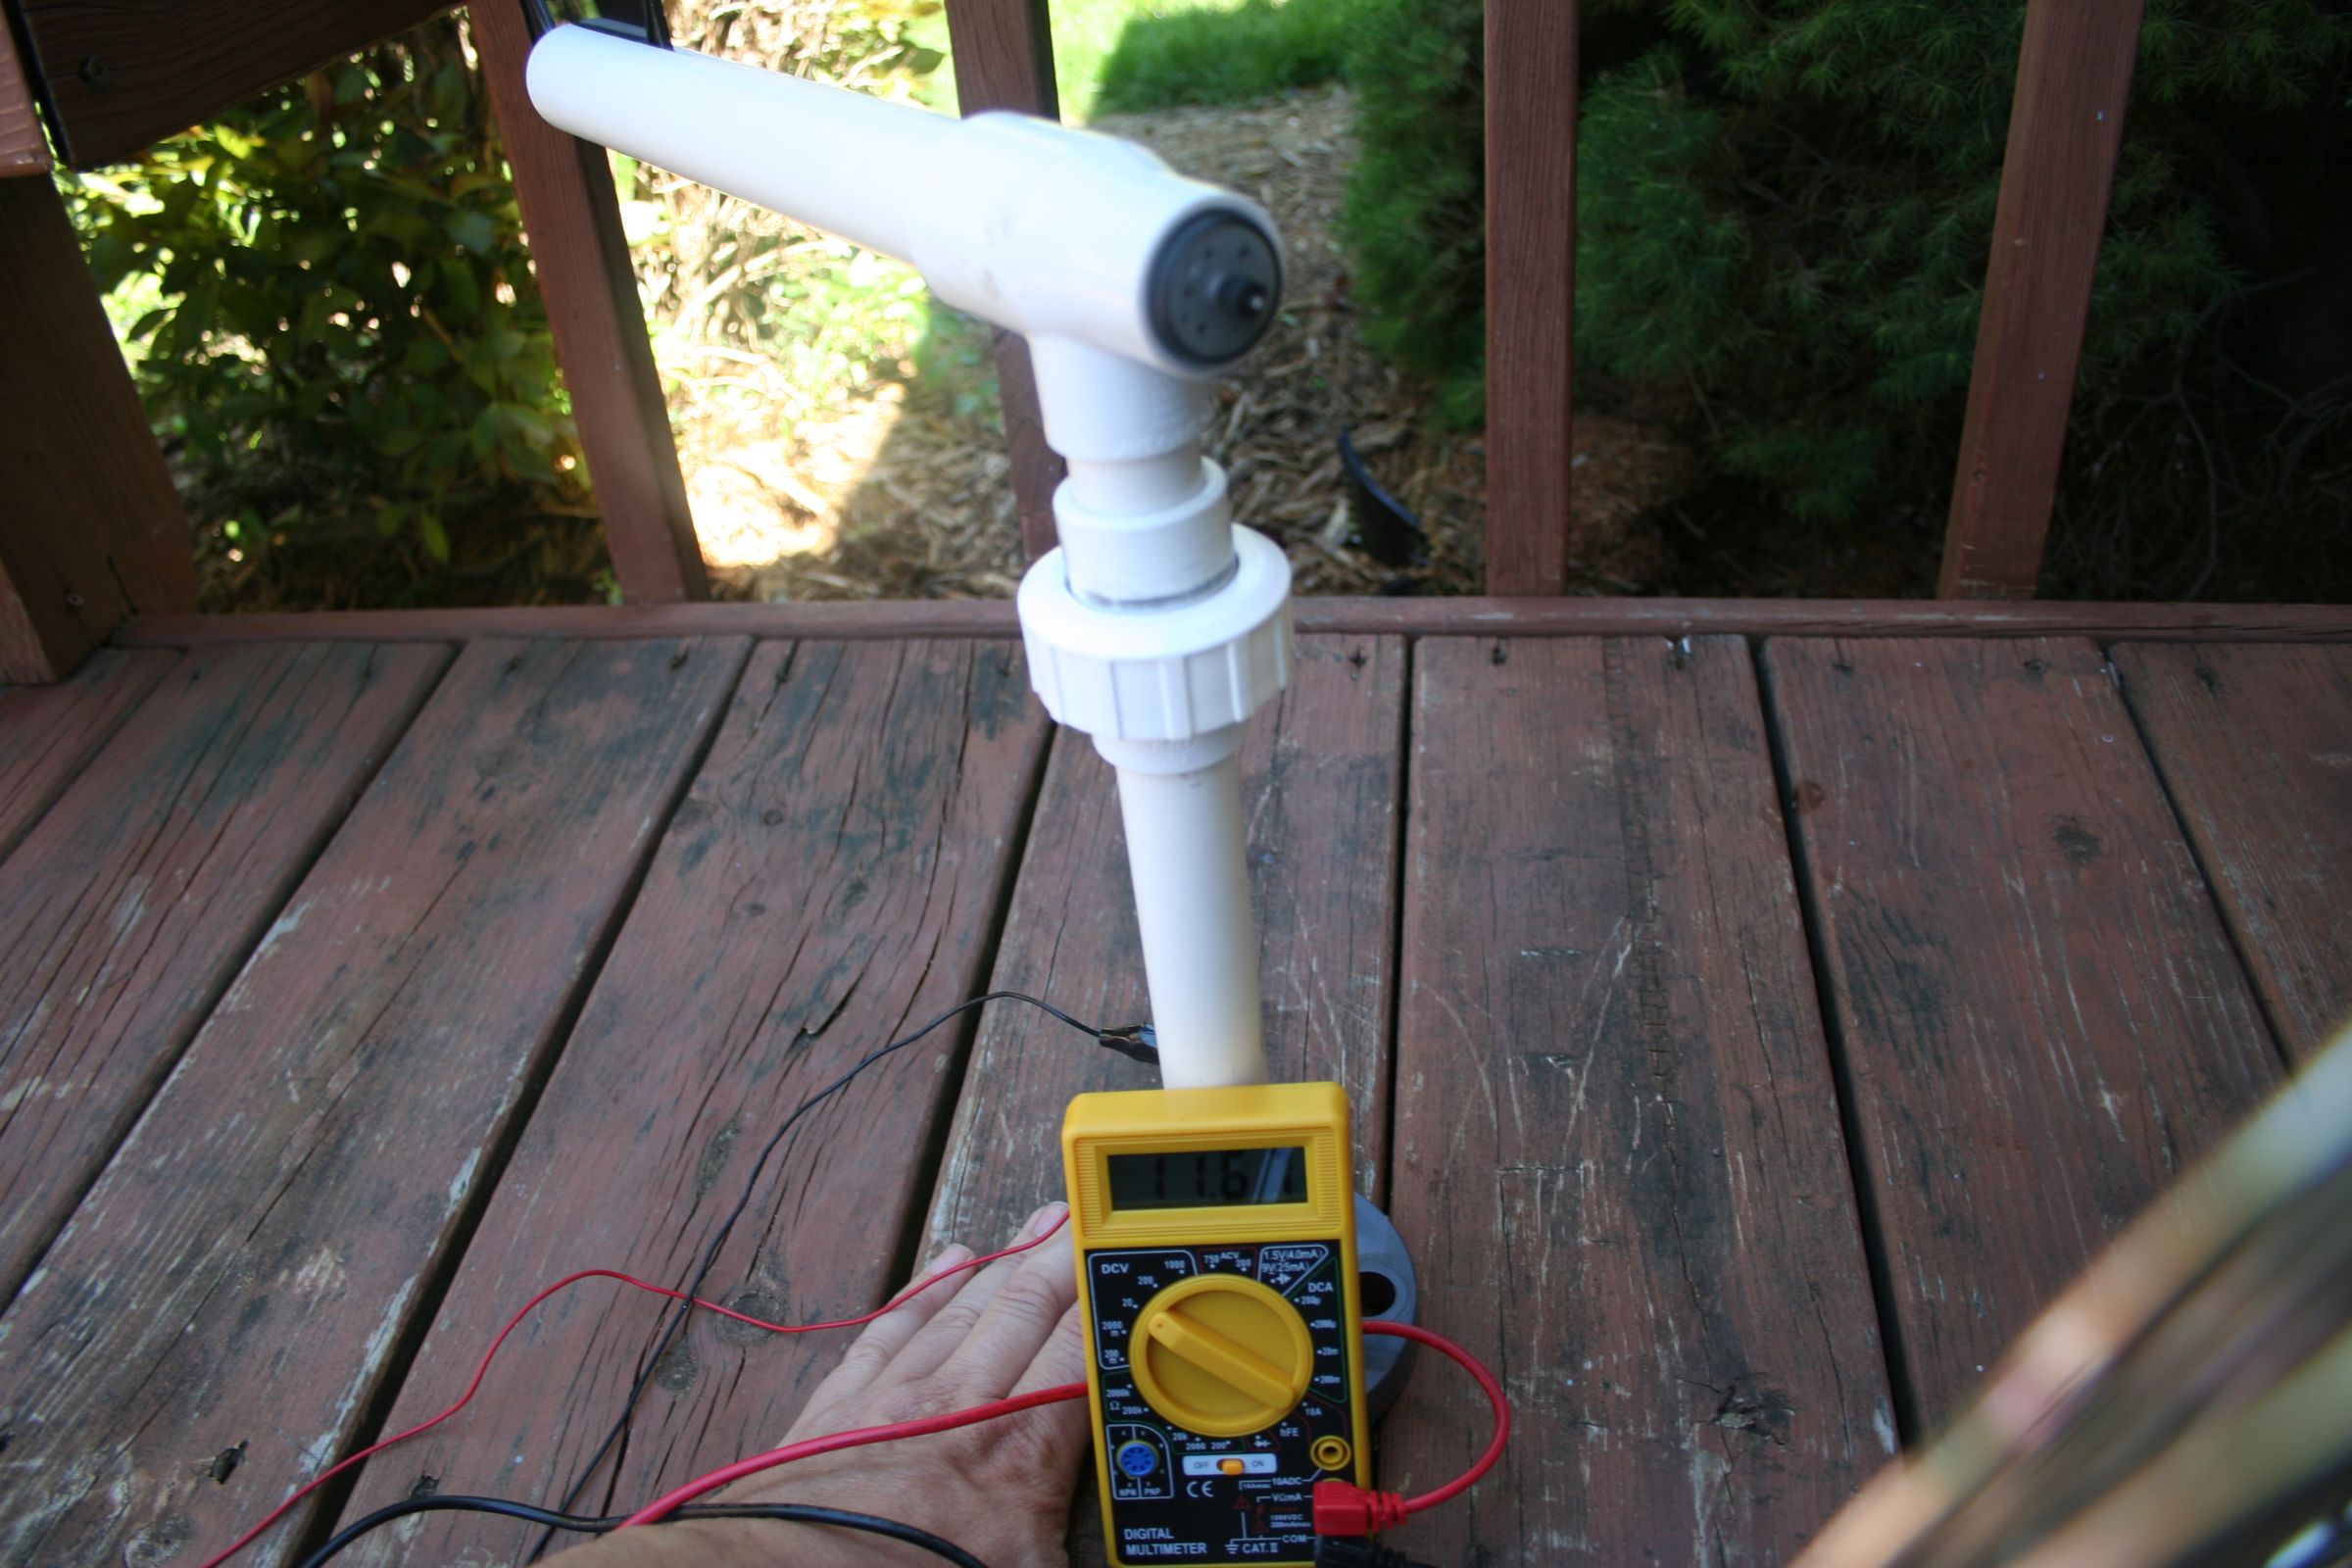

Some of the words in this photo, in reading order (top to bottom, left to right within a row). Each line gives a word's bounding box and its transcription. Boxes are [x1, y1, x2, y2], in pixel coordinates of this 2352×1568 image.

[1102, 1263, 1129, 1274] DCV
[1164, 1260, 1185, 1269] 1000
[1137, 1275, 1154, 1285] 200
[1308, 1282, 1333, 1293] DCA
[1305, 1407, 1322, 1416] 10A
[1194, 1460, 1209, 1470] OFF
[1187, 1481, 1213, 1497] CE
[1124, 1528, 1174, 1541] DIGITAL
[1126, 1543, 1207, 1555] MULTIMETER
